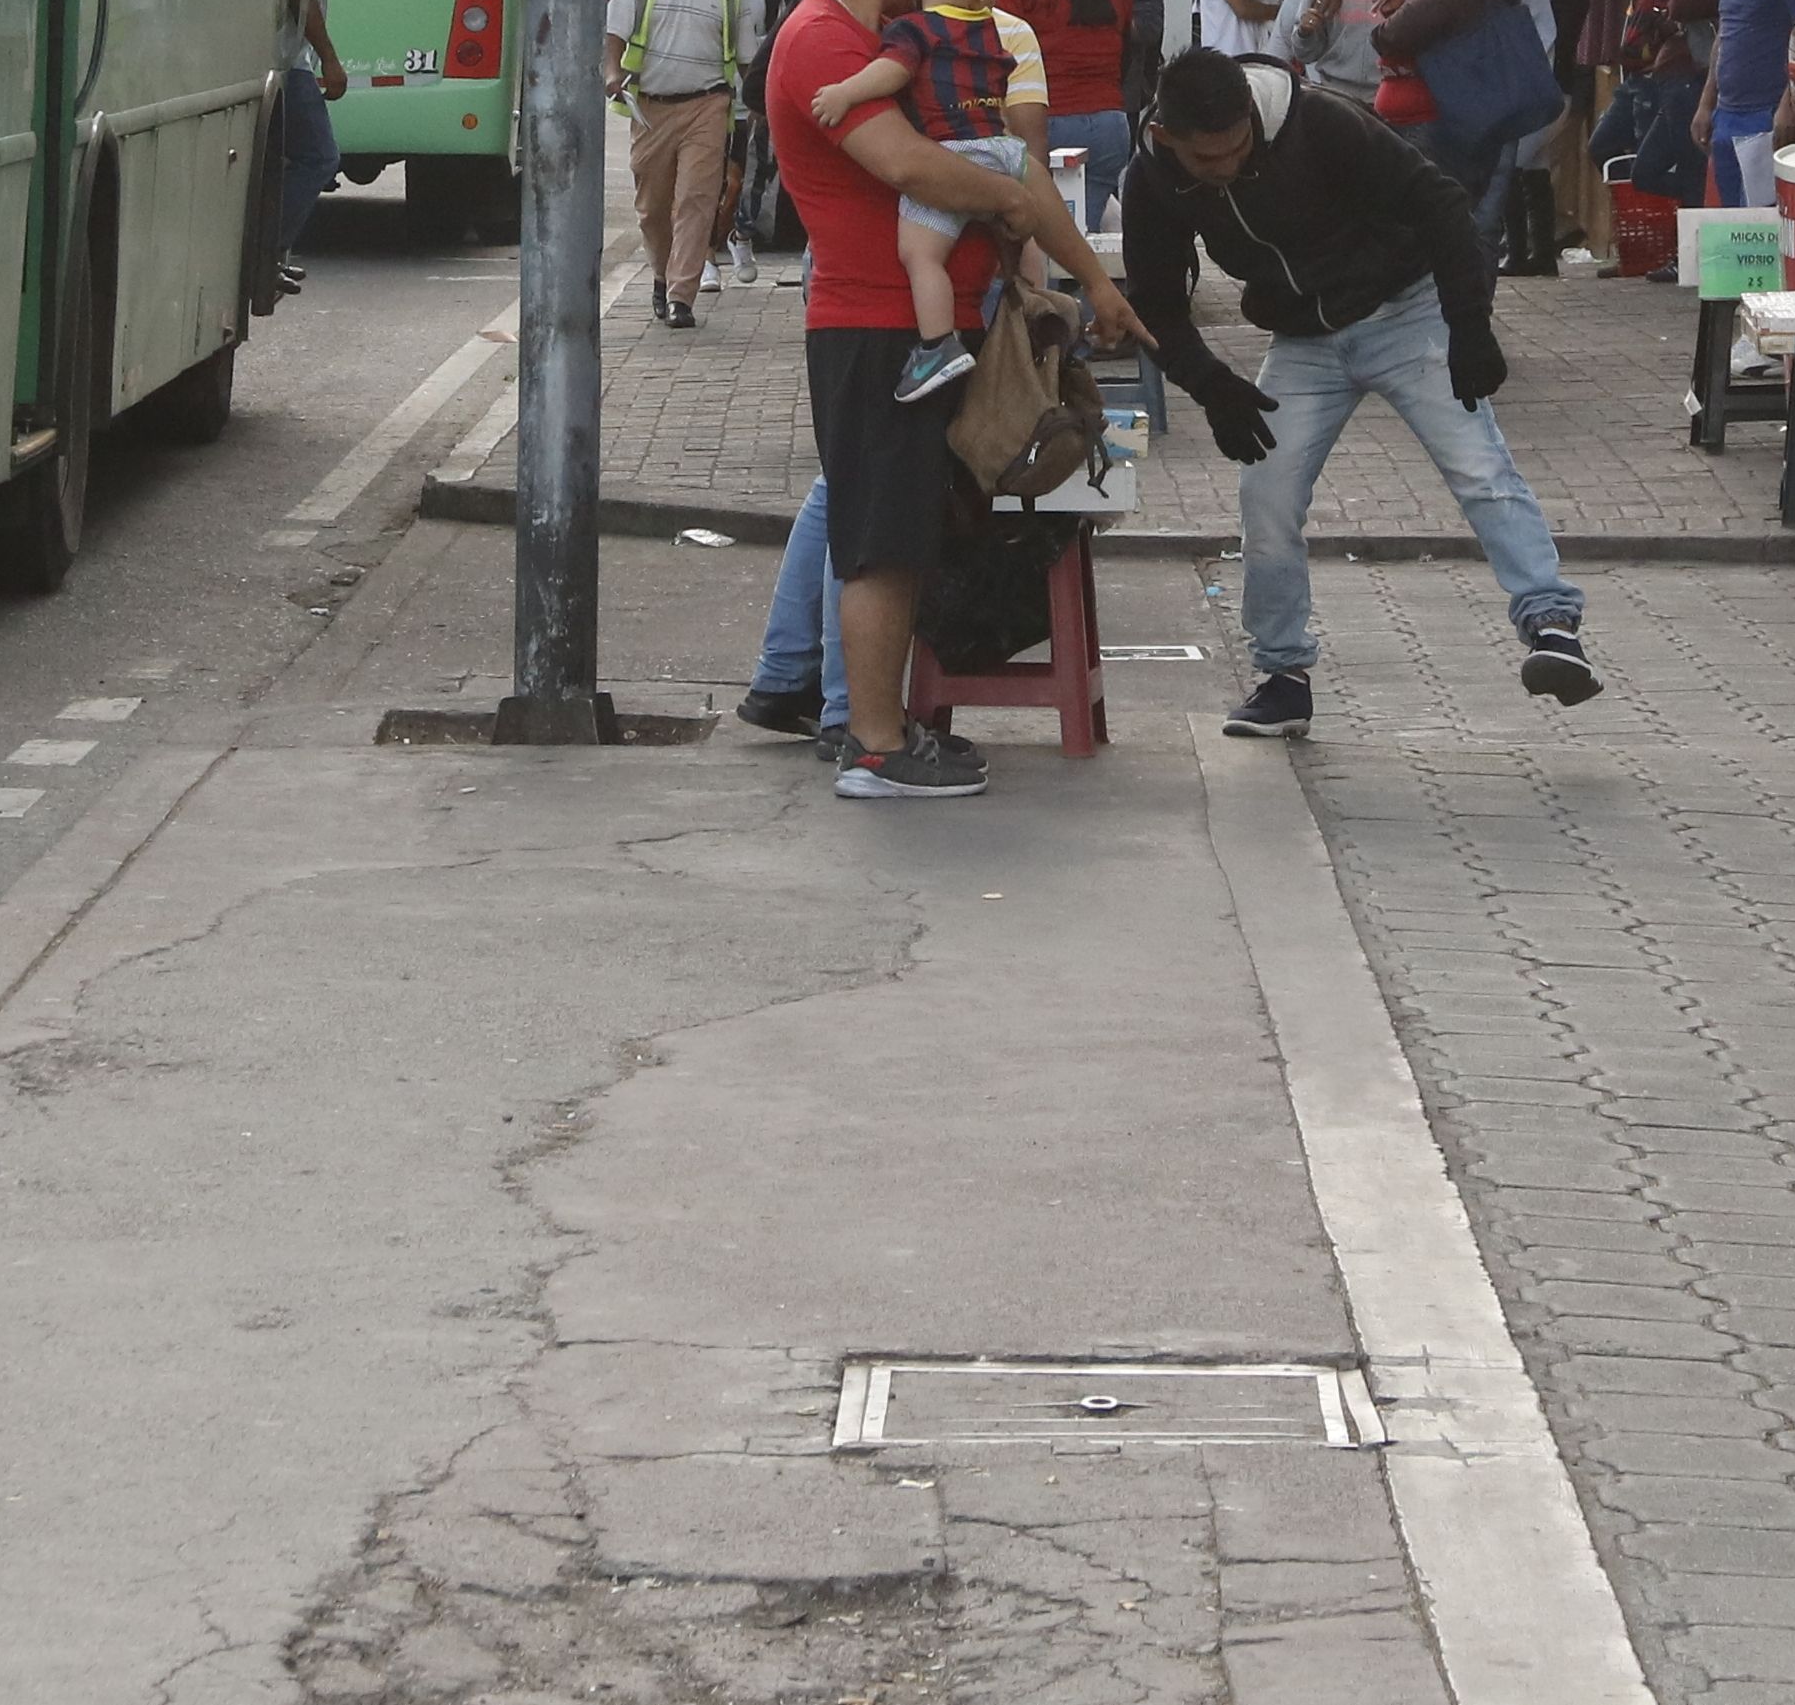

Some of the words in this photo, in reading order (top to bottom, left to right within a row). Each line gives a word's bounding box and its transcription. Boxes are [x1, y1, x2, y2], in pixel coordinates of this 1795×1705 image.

[404, 48, 439, 74] 31
[1730, 231, 1765, 242] MICAS
[1737, 254, 1775, 266] VIDRIO
[1747, 277, 1755, 287] 2
[1756, 276, 1764, 288] $
